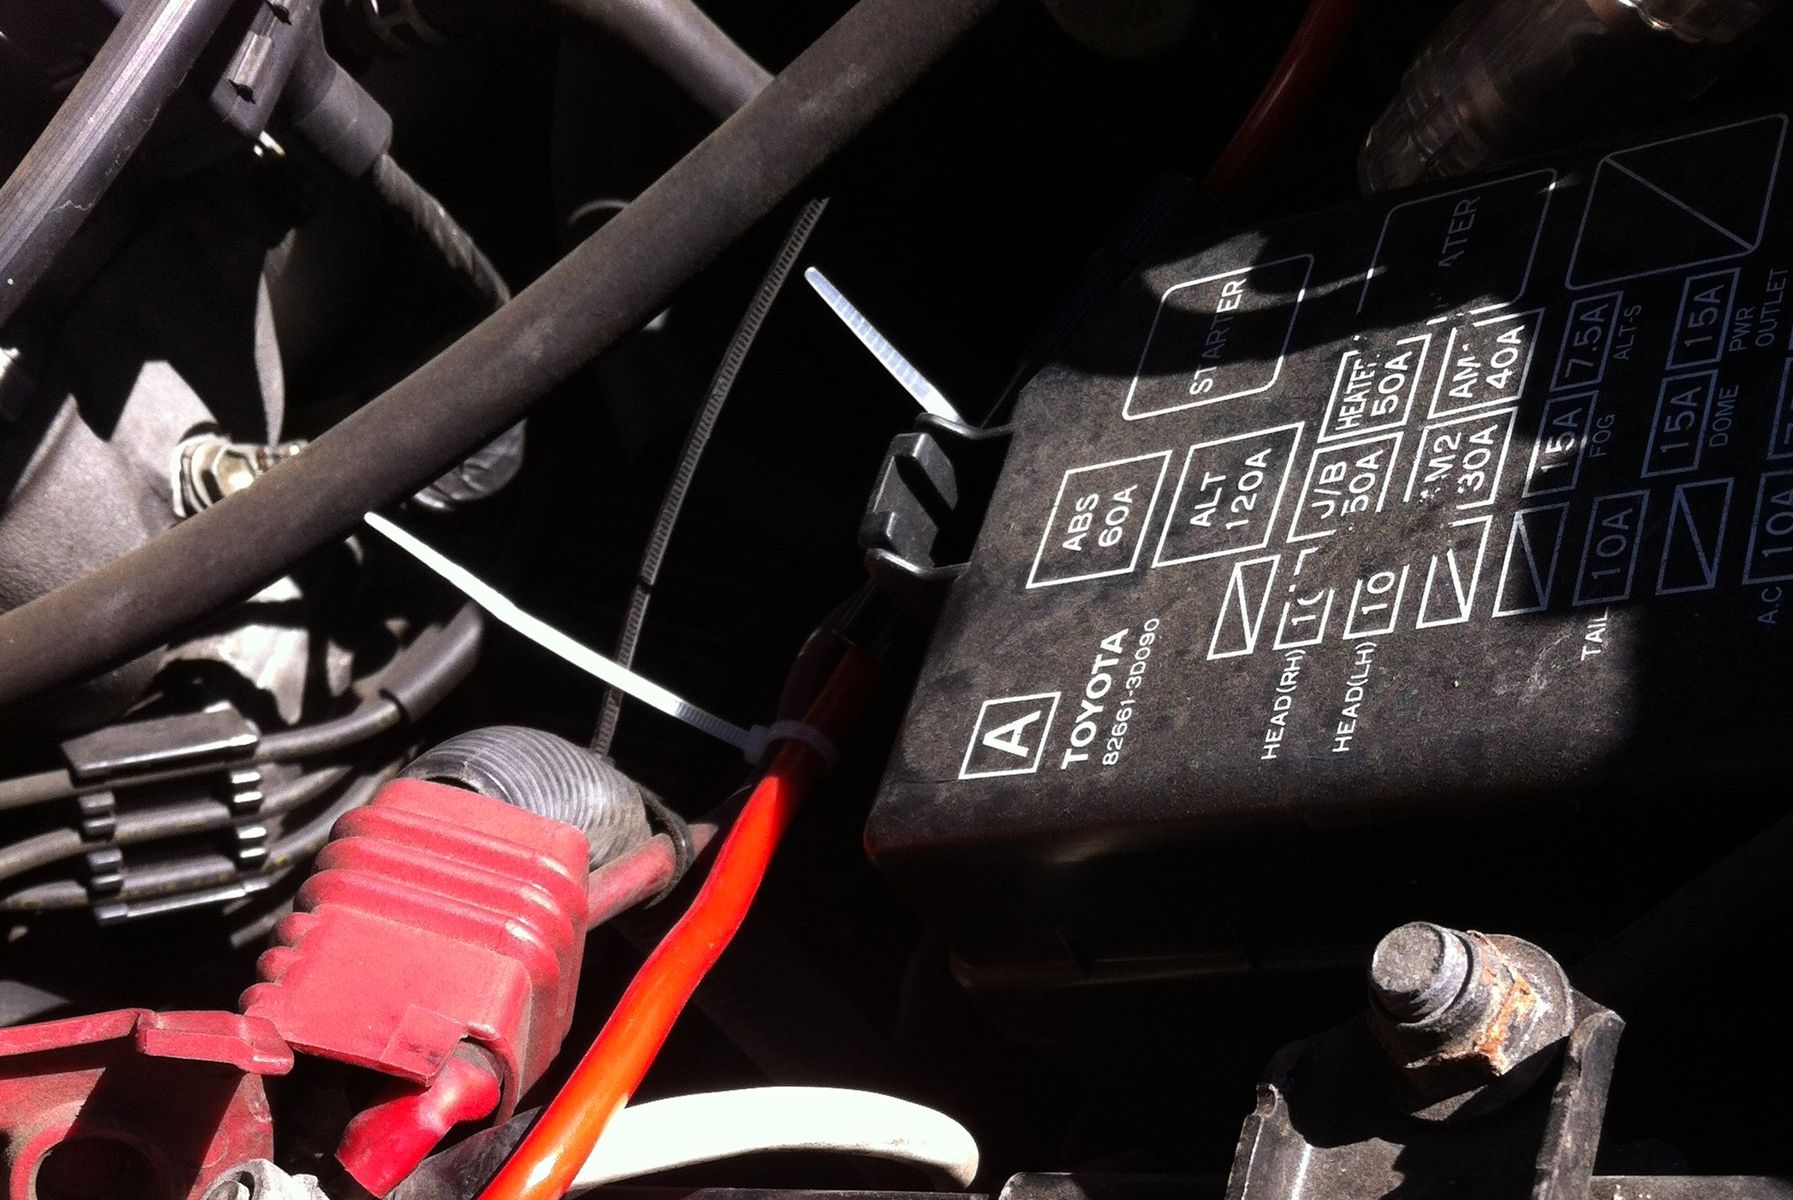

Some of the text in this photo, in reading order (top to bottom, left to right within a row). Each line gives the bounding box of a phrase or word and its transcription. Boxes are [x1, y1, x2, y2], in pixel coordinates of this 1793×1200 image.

[1189, 277, 1249, 396] STARTER
[1565, 303, 1609, 378] 7.5A
[1685, 283, 1725, 349] 15A
[1728, 305, 1758, 353] PWR
[1754, 266, 1791, 348] OUTLET
[1371, 351, 1413, 417] 50A
[1486, 325, 1525, 390] 40A
[1540, 407, 1583, 474] 15A
[1587, 413, 1616, 459] FOG
[1659, 386, 1702, 453] 15A
[1709, 384, 1740, 448] DOME
[1226, 448, 1272, 531] 120A
[1311, 460, 1348, 520] J/B
[1341, 450, 1384, 517] 50A
[1461, 424, 1499, 493] 30A
[1062, 492, 1099, 551] ABS
[1098, 484, 1138, 548] 60A
[1190, 471, 1227, 528] ALT
[1591, 507, 1634, 581] 10A
[1580, 606, 1611, 661] TAIL
[1061, 628, 1129, 769] TOYOTA
[1102, 617, 1160, 766] 82661-3D090
[1261, 649, 1306, 760] HEAD(RH)
[1332, 641, 1378, 753] HEAD(LH)
[982, 710, 1042, 758] A
